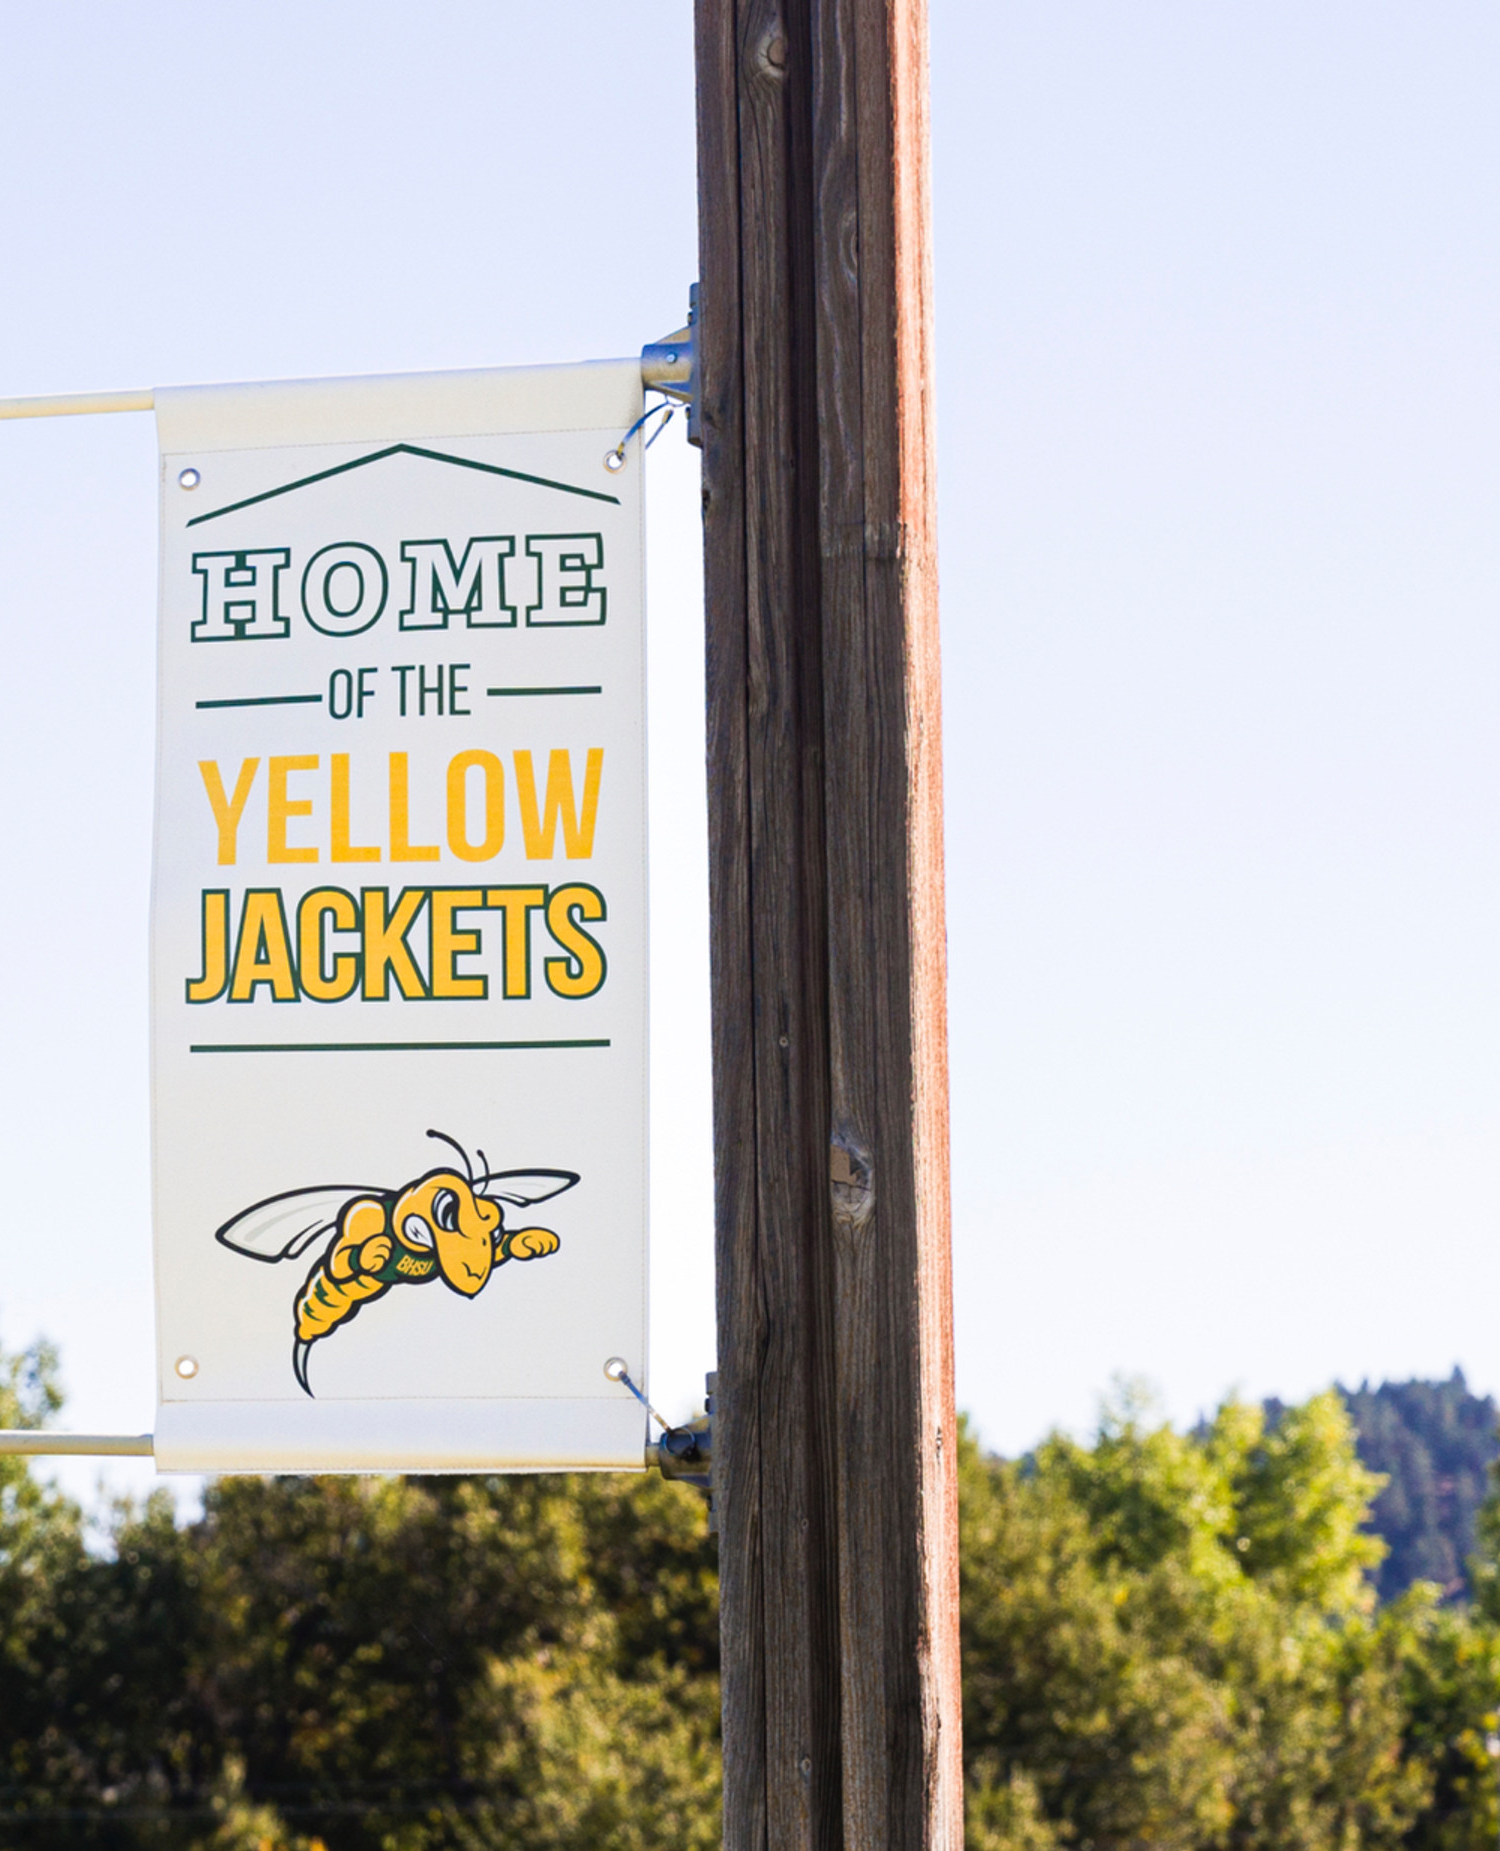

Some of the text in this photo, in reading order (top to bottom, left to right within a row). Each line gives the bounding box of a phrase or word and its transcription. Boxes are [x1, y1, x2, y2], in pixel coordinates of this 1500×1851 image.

[190, 532, 608, 643] HOME
[328, 663, 472, 720] OF THE
[196, 747, 605, 866] YELLOW
[185, 881, 608, 1005] JACKETS
[395, 1254, 434, 1276] BHSU
